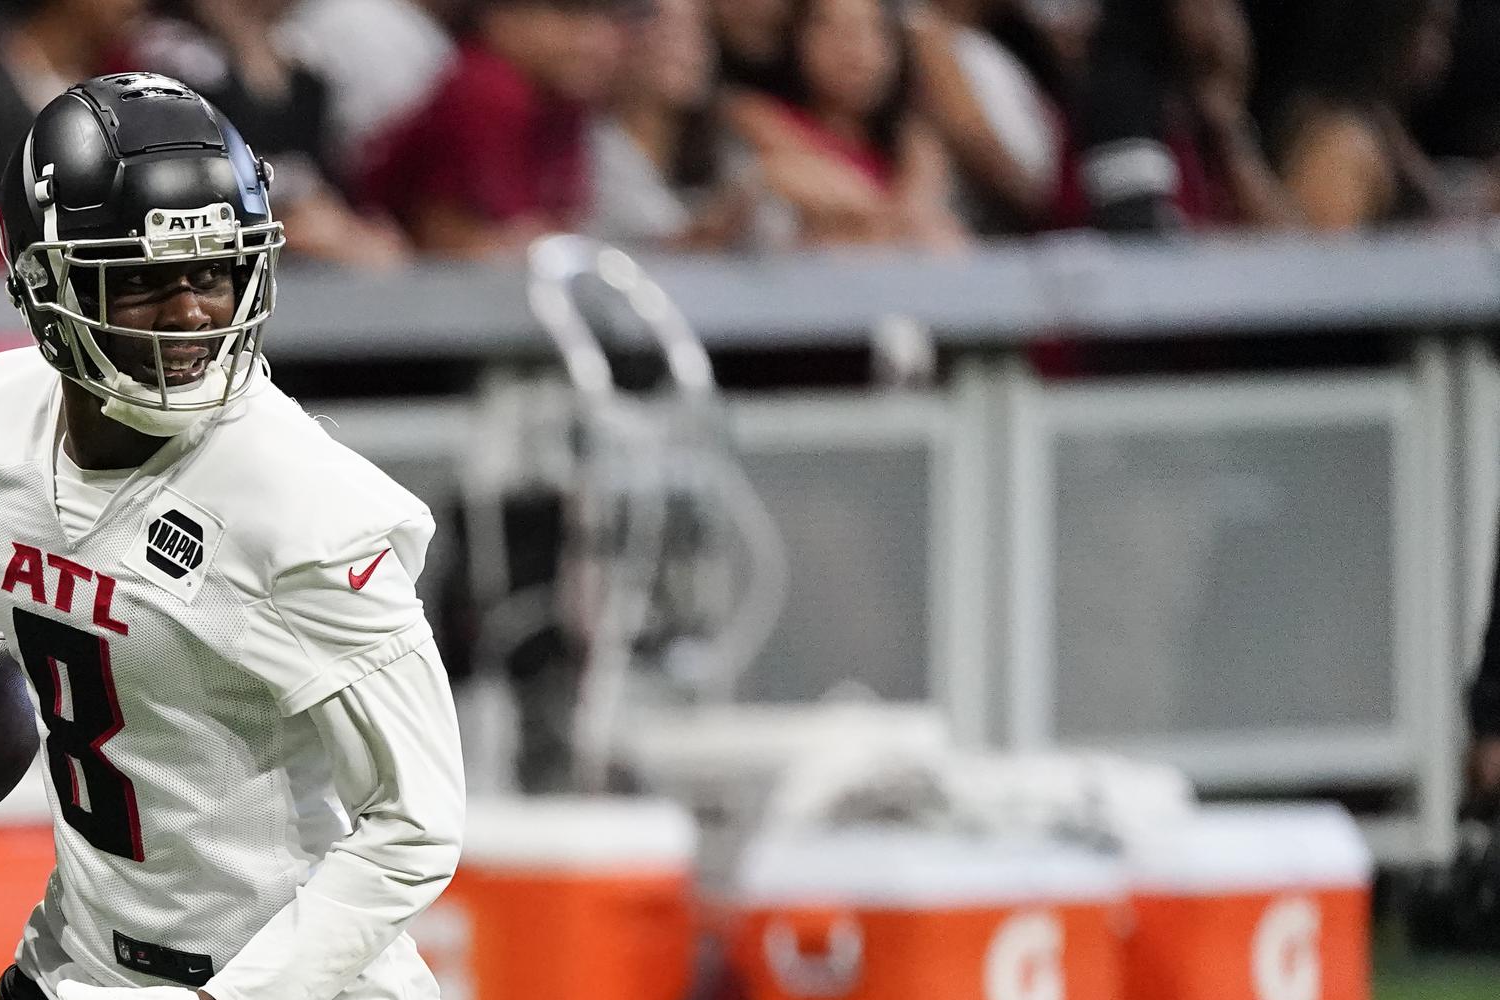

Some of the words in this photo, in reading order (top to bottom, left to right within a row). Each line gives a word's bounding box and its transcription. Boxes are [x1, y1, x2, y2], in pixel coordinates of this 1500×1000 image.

[169, 214, 212, 230] ATL
[153, 521, 198, 568] NAPA
[1, 541, 129, 636] ATL
[12, 606, 145, 863] 8
